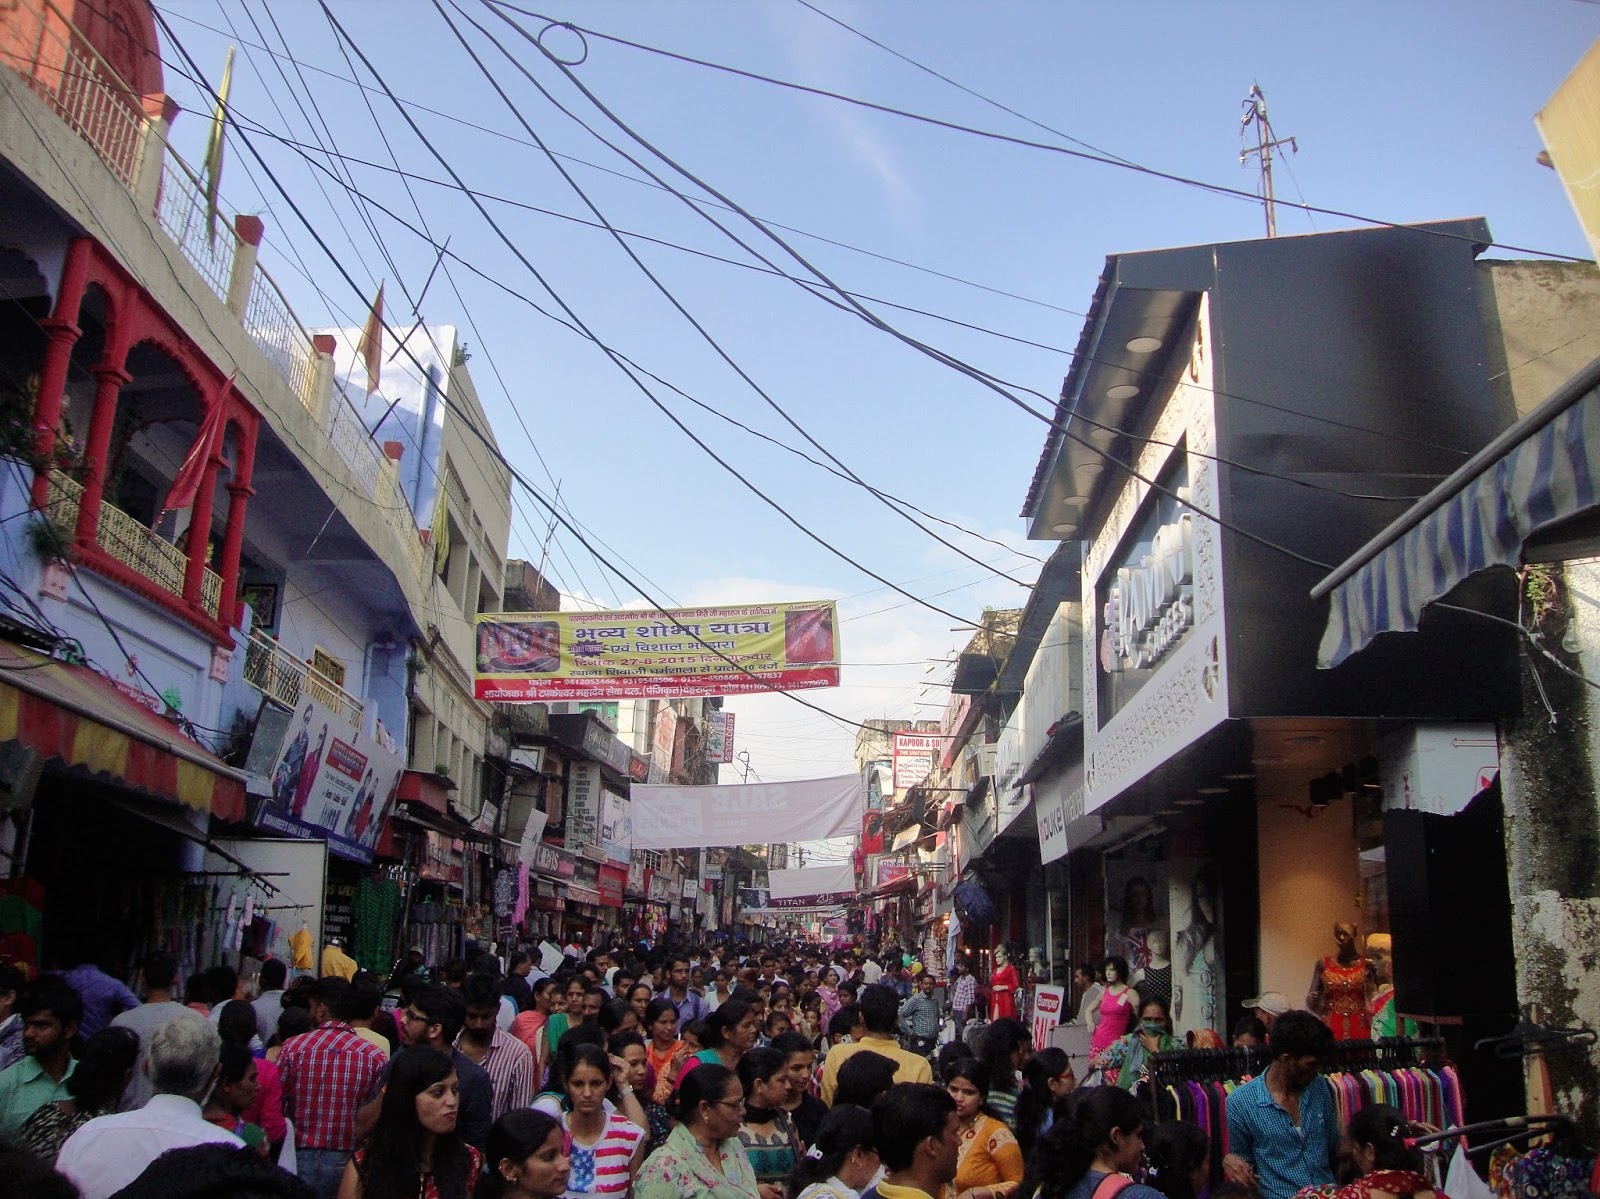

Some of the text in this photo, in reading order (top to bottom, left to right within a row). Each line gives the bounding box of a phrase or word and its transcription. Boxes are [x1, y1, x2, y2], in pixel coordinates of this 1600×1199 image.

[575, 621, 770, 640] भव्य शोभा यात्रा
[610, 642, 630, 653] एवं
[635, 641, 682, 652] विशाल
[620, 656, 696, 666] 27-8-2015
[606, 667, 646, 676] शिवाजी
[700, 664, 710, 673] से
[526, 687, 537, 698] श्री
[576, 686, 604, 697] महादेव
[606, 685, 622, 696] सेवा
[899, 737, 925, 747] KAPOOR
[925, 739, 930, 748] &
[1038, 994, 1059, 1010] Bumper
